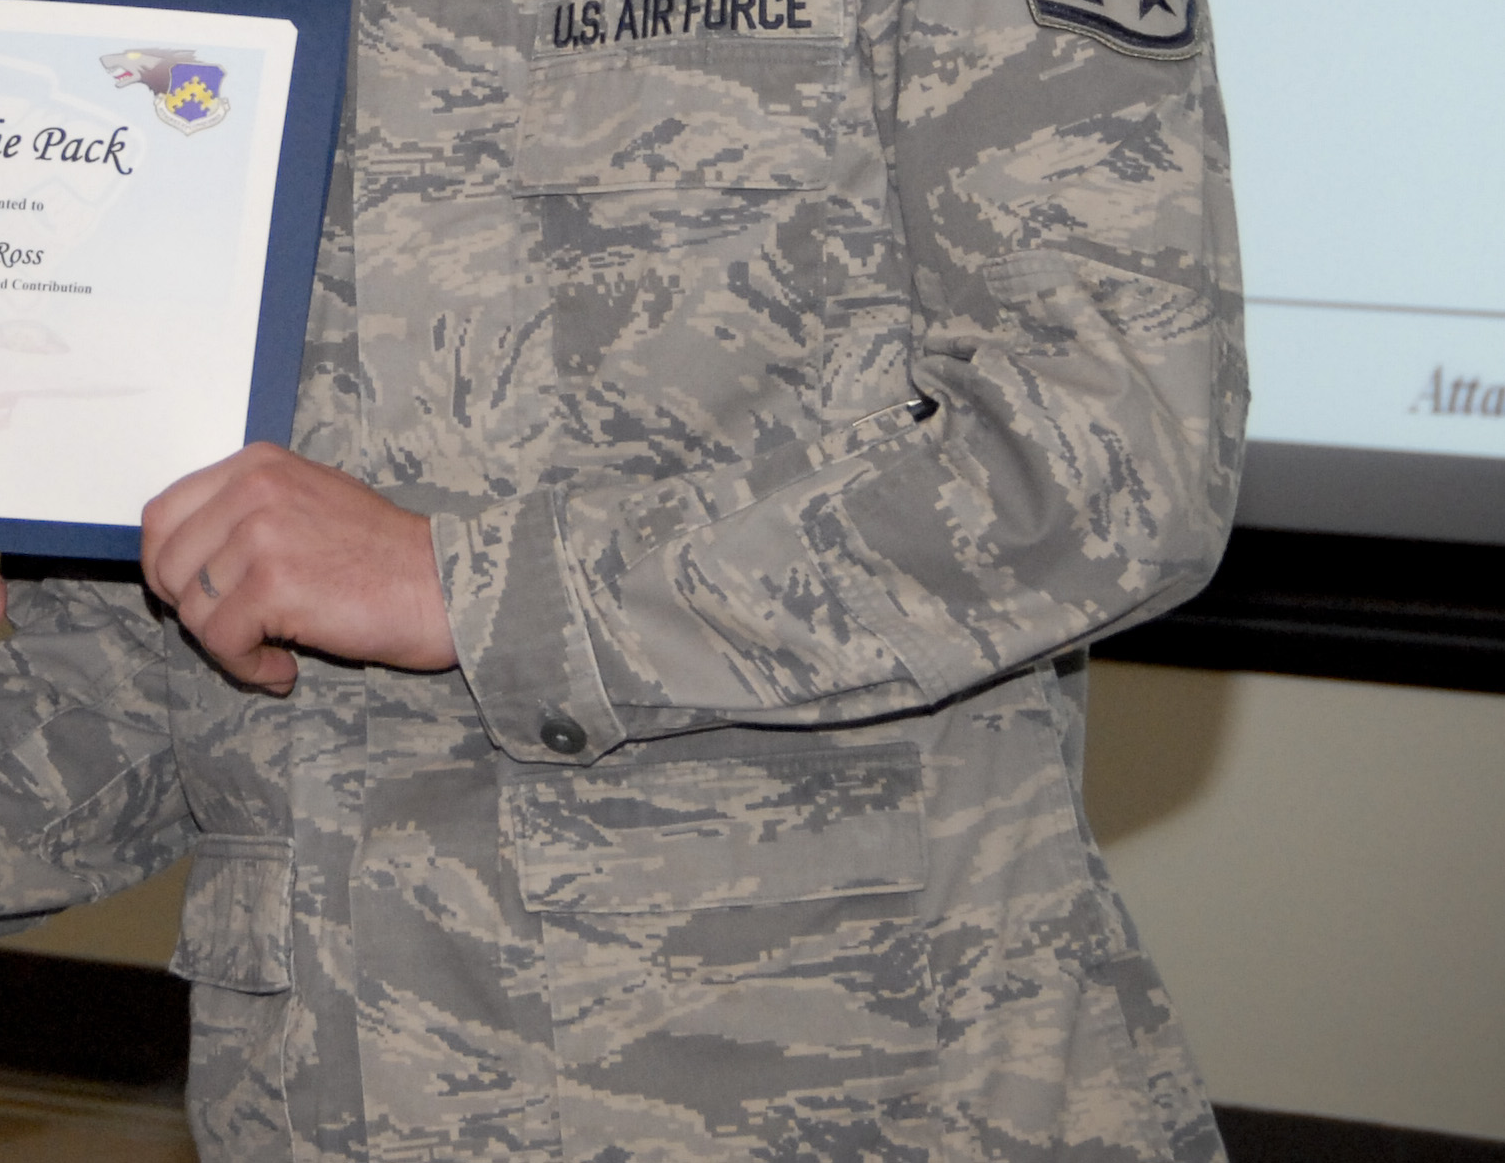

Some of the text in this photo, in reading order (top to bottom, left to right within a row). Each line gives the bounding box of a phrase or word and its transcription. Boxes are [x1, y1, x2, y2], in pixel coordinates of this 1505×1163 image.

[553, 0, 608, 49] U.S.
[33, 126, 133, 175] Pack
[31, 200, 44, 212] to
[12, 278, 93, 294] Contribution
